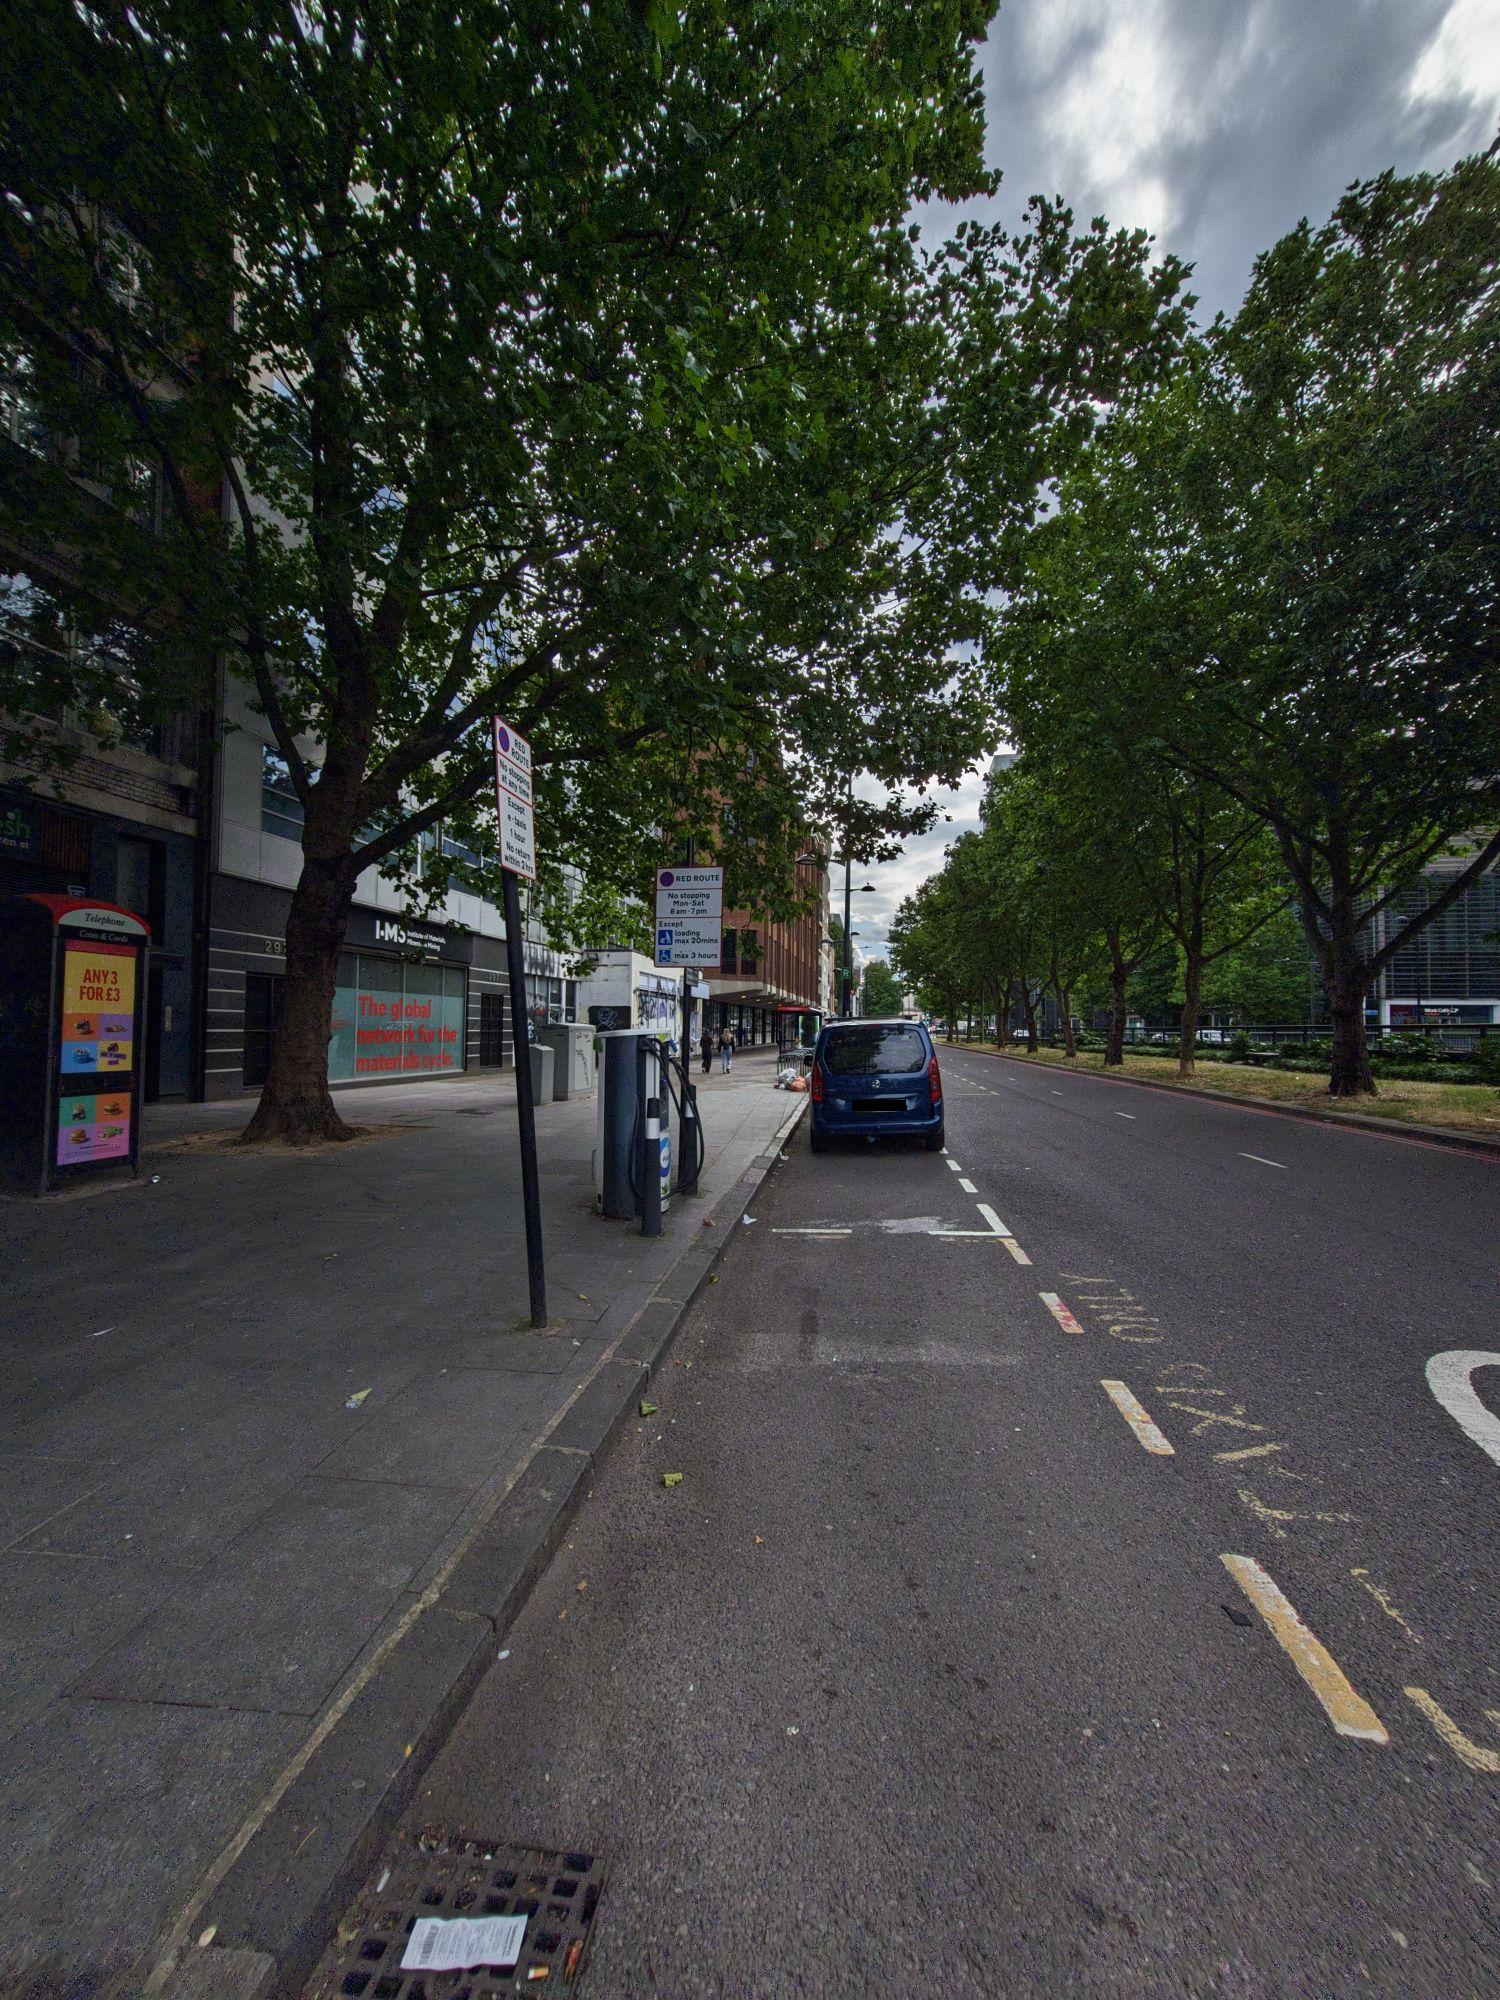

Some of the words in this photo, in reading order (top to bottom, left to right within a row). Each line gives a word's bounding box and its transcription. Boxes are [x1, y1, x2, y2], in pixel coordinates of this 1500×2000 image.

[514, 738, 525, 754] RED
[511, 747, 529, 769] ROUTE
[500, 759, 508, 773] No
[509, 768, 530, 790] stopping
[501, 774, 507, 785] at
[508, 781, 518, 793] any
[518, 784, 530, 800] time
[507, 796, 526, 816] Except
[514, 829, 526, 844] hour
[506, 841, 514, 853] No
[515, 848, 531, 861] return
[504, 854, 520, 868] within
[525, 864, 534, 874] hrs
[693, 874, 720, 882] ROUTE
[680, 891, 710, 899] stopping
[85, 912, 127, 927] Telephone
[658, 920, 683, 929] Except
[674, 930, 700, 938] loading
[83, 968, 110, 984] ANY
[110, 970, 118, 985] 3
[79, 985, 104, 1001] FOR
[105, 987, 120, 1002] £3
[358, 994, 387, 1016] The
[390, 997, 432, 1021] global
[356, 1024, 416, 1044] network
[418, 1023, 435, 1043] for
[438, 1024, 457, 1043] the
[355, 1050, 420, 1073] materials
